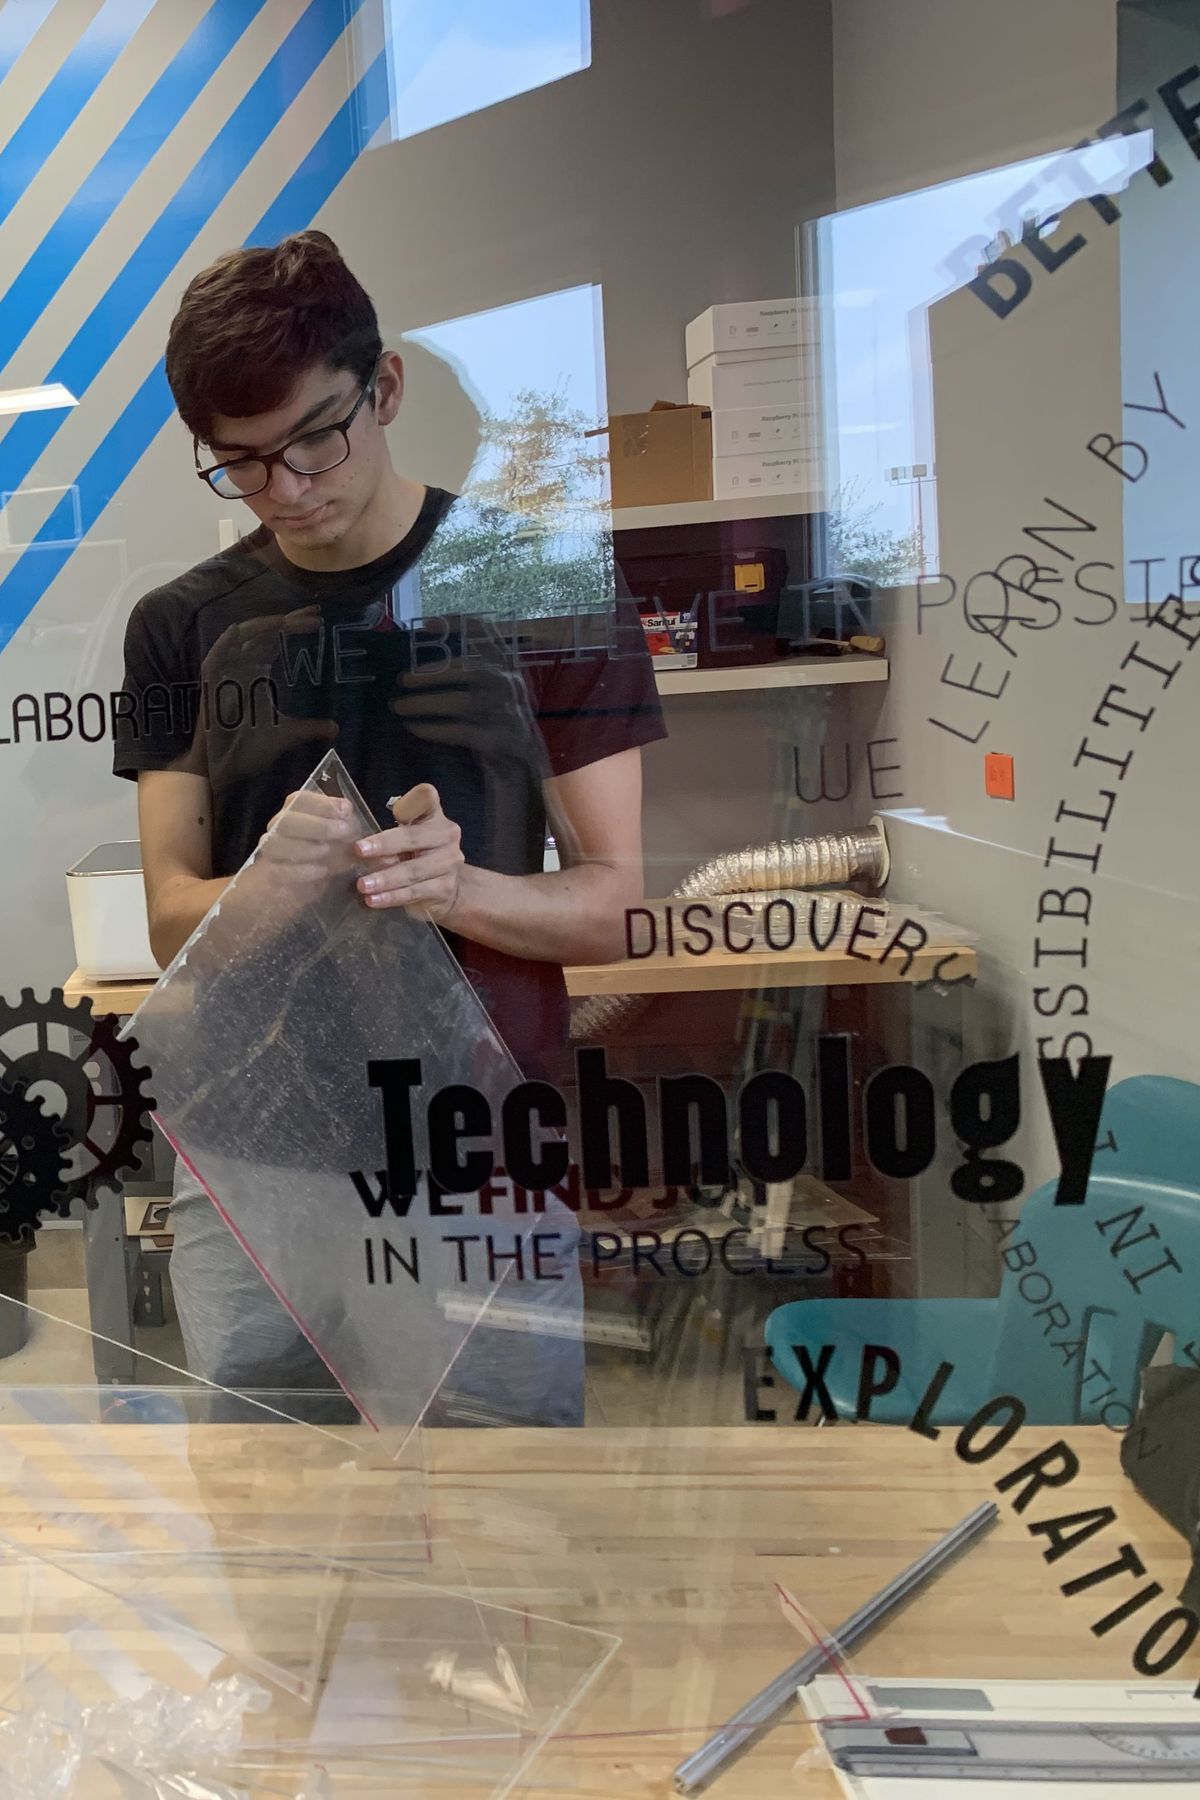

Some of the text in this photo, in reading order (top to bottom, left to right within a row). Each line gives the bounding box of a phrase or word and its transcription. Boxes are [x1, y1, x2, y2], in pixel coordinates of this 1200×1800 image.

[278, 620, 379, 688] WE
[409, 589, 755, 675] BELIEVE
[794, 371, 1186, 803] WE LEARN BY
[367, 1034, 1113, 1206] Technology
[364, 1237, 421, 1285] IN
[442, 1231, 564, 1283] THE
[741, 1344, 1200, 1700] EXPLORATIO
